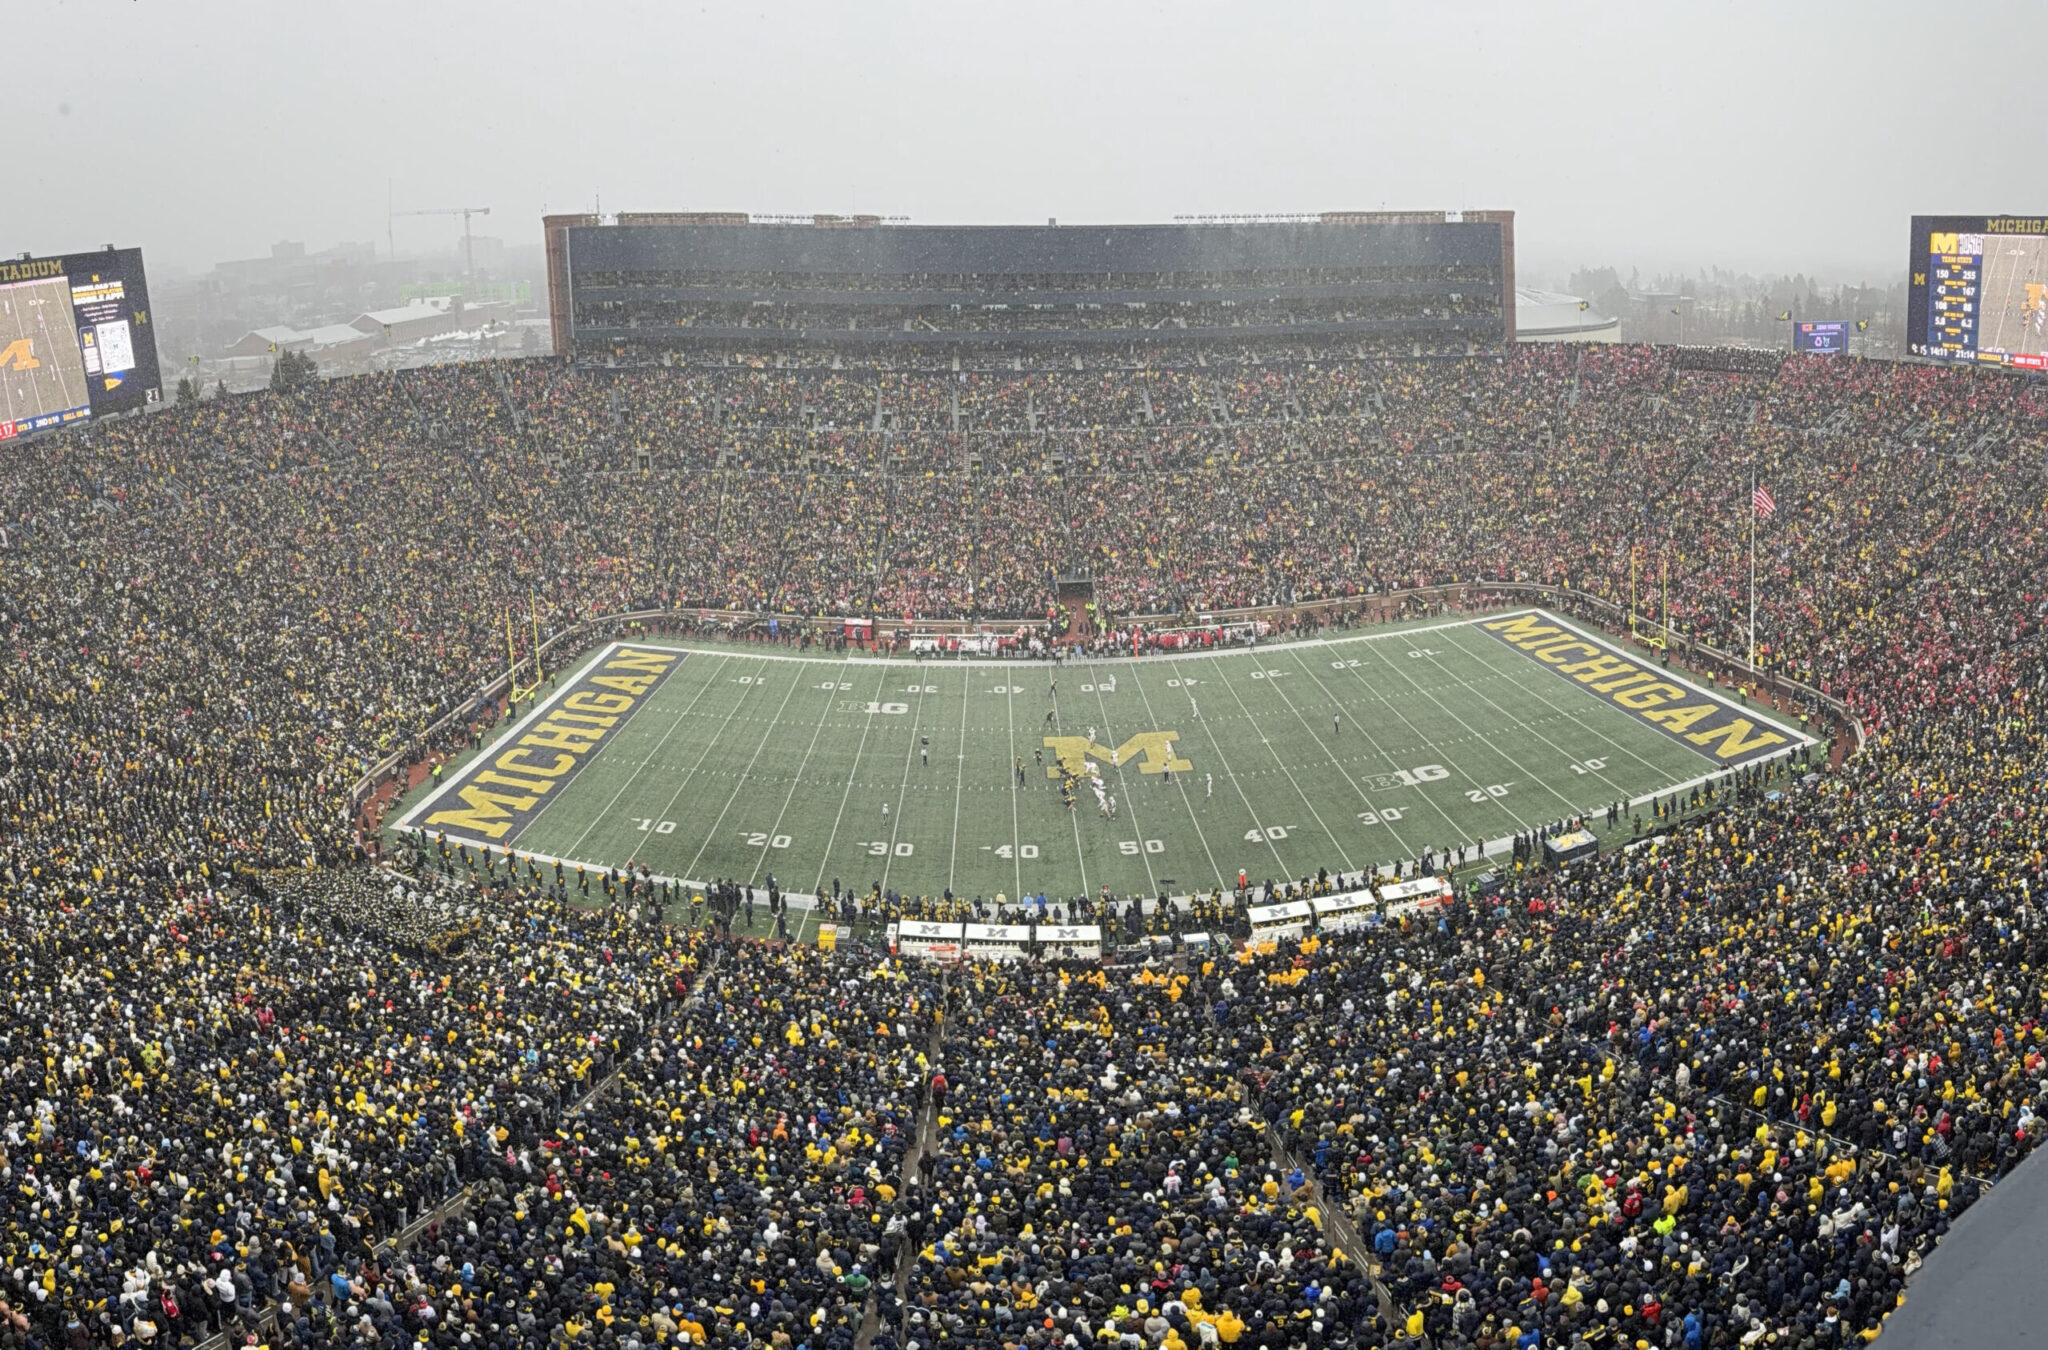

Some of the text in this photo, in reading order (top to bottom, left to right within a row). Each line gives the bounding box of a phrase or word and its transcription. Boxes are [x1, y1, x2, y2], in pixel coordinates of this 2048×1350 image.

[0, 259, 64, 281] TADIUM
[1936, 269, 1976, 280] 150 255
[1937, 285, 1946, 295] 42
[134, 310, 148, 326] M
[1955, 349, 1975, 359] 21:14
[2003, 354, 2010, 363] 9
[3, 424, 13, 436] 17
[1407, 648, 1437, 658] 10
[1331, 659, 1362, 670] 20
[1250, 669, 1283, 679] 30
[738, 676, 766, 685] 10
[821, 681, 853, 691] 20
[1166, 678, 1198, 688] 40
[907, 684, 939, 693] 30
[993, 686, 1025, 694] 40
[1483, 615, 1788, 759] MICHIGAN
[424, 649, 677, 839] MICHIGAN
[1570, 757, 1607, 775] 10
[1465, 783, 1509, 804] 20
[1357, 807, 1402, 826] 30
[636, 818, 677, 835] 10
[1243, 825, 1289, 842] 40
[747, 832, 792, 849] 20
[868, 842, 914, 857] 30
[994, 844, 1039, 859] 40
[1118, 839, 1166, 856] 50
[1267, 905, 1291, 918] M
[920, 924, 941, 935] M
[1058, 928, 1079, 939] M
